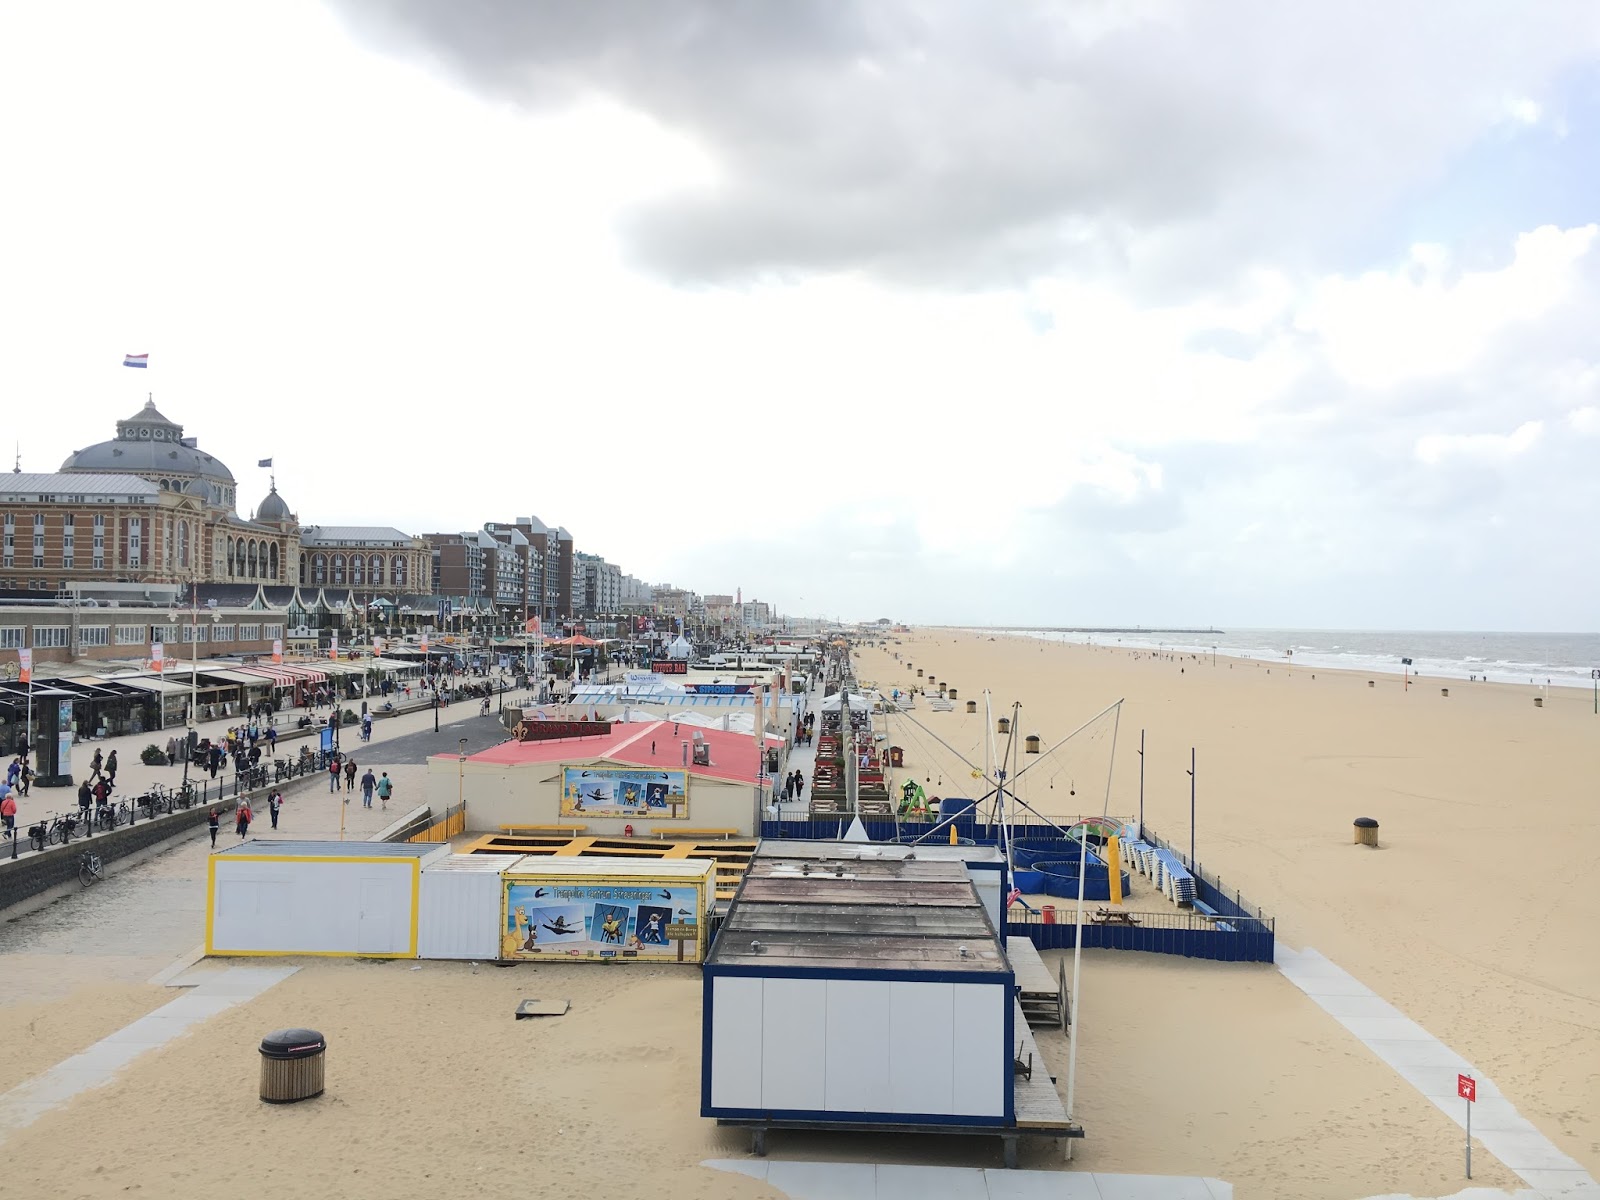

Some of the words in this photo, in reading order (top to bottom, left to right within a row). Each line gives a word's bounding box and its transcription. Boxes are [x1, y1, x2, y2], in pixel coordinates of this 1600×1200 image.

[652, 663, 673, 673] COYOTE
[674, 663, 686, 674] BAR
[698, 685, 736, 694] SIMONIS
[530, 722, 568, 734] GRAND
[586, 887, 611, 899] Centrum
